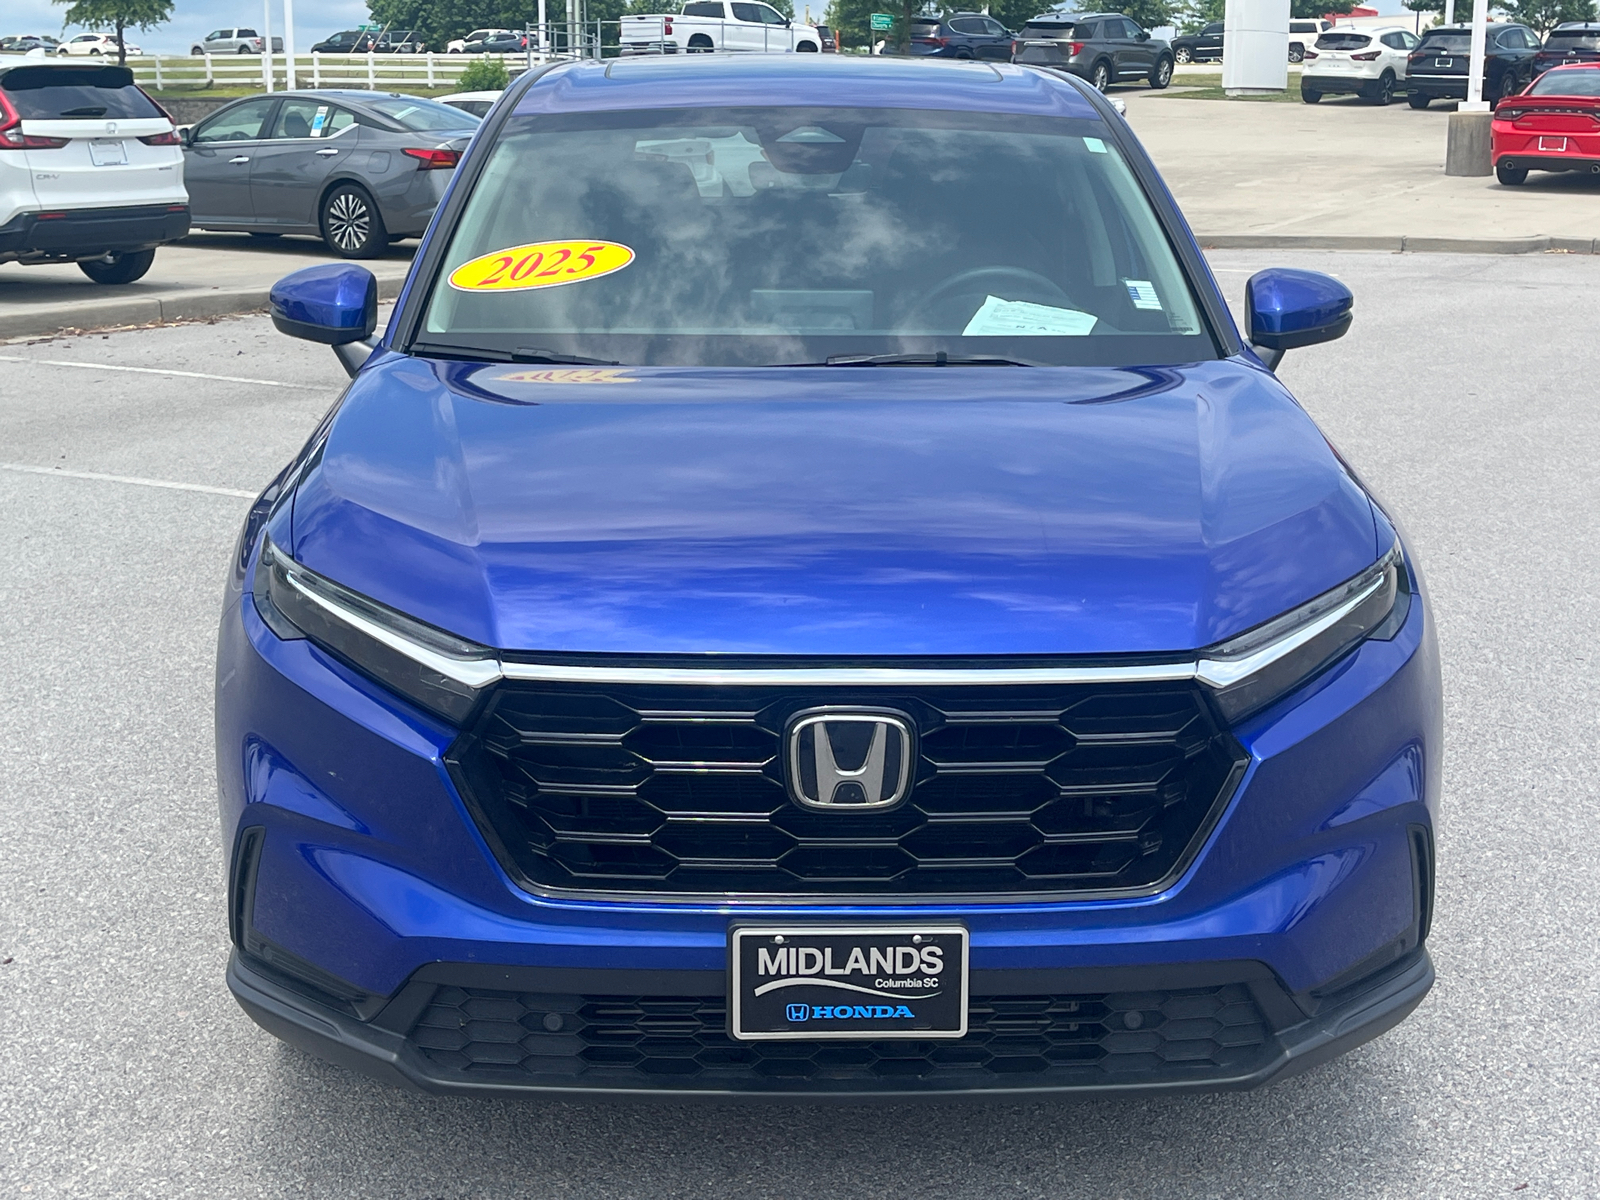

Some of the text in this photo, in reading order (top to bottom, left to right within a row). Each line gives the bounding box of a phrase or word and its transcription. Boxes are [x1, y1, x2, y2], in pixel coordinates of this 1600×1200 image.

[476, 245, 606, 287] 2025
[757, 946, 944, 976] MIDLANDS
[874, 977, 939, 989] Columbia SC
[811, 1005, 915, 1018] HONDA
